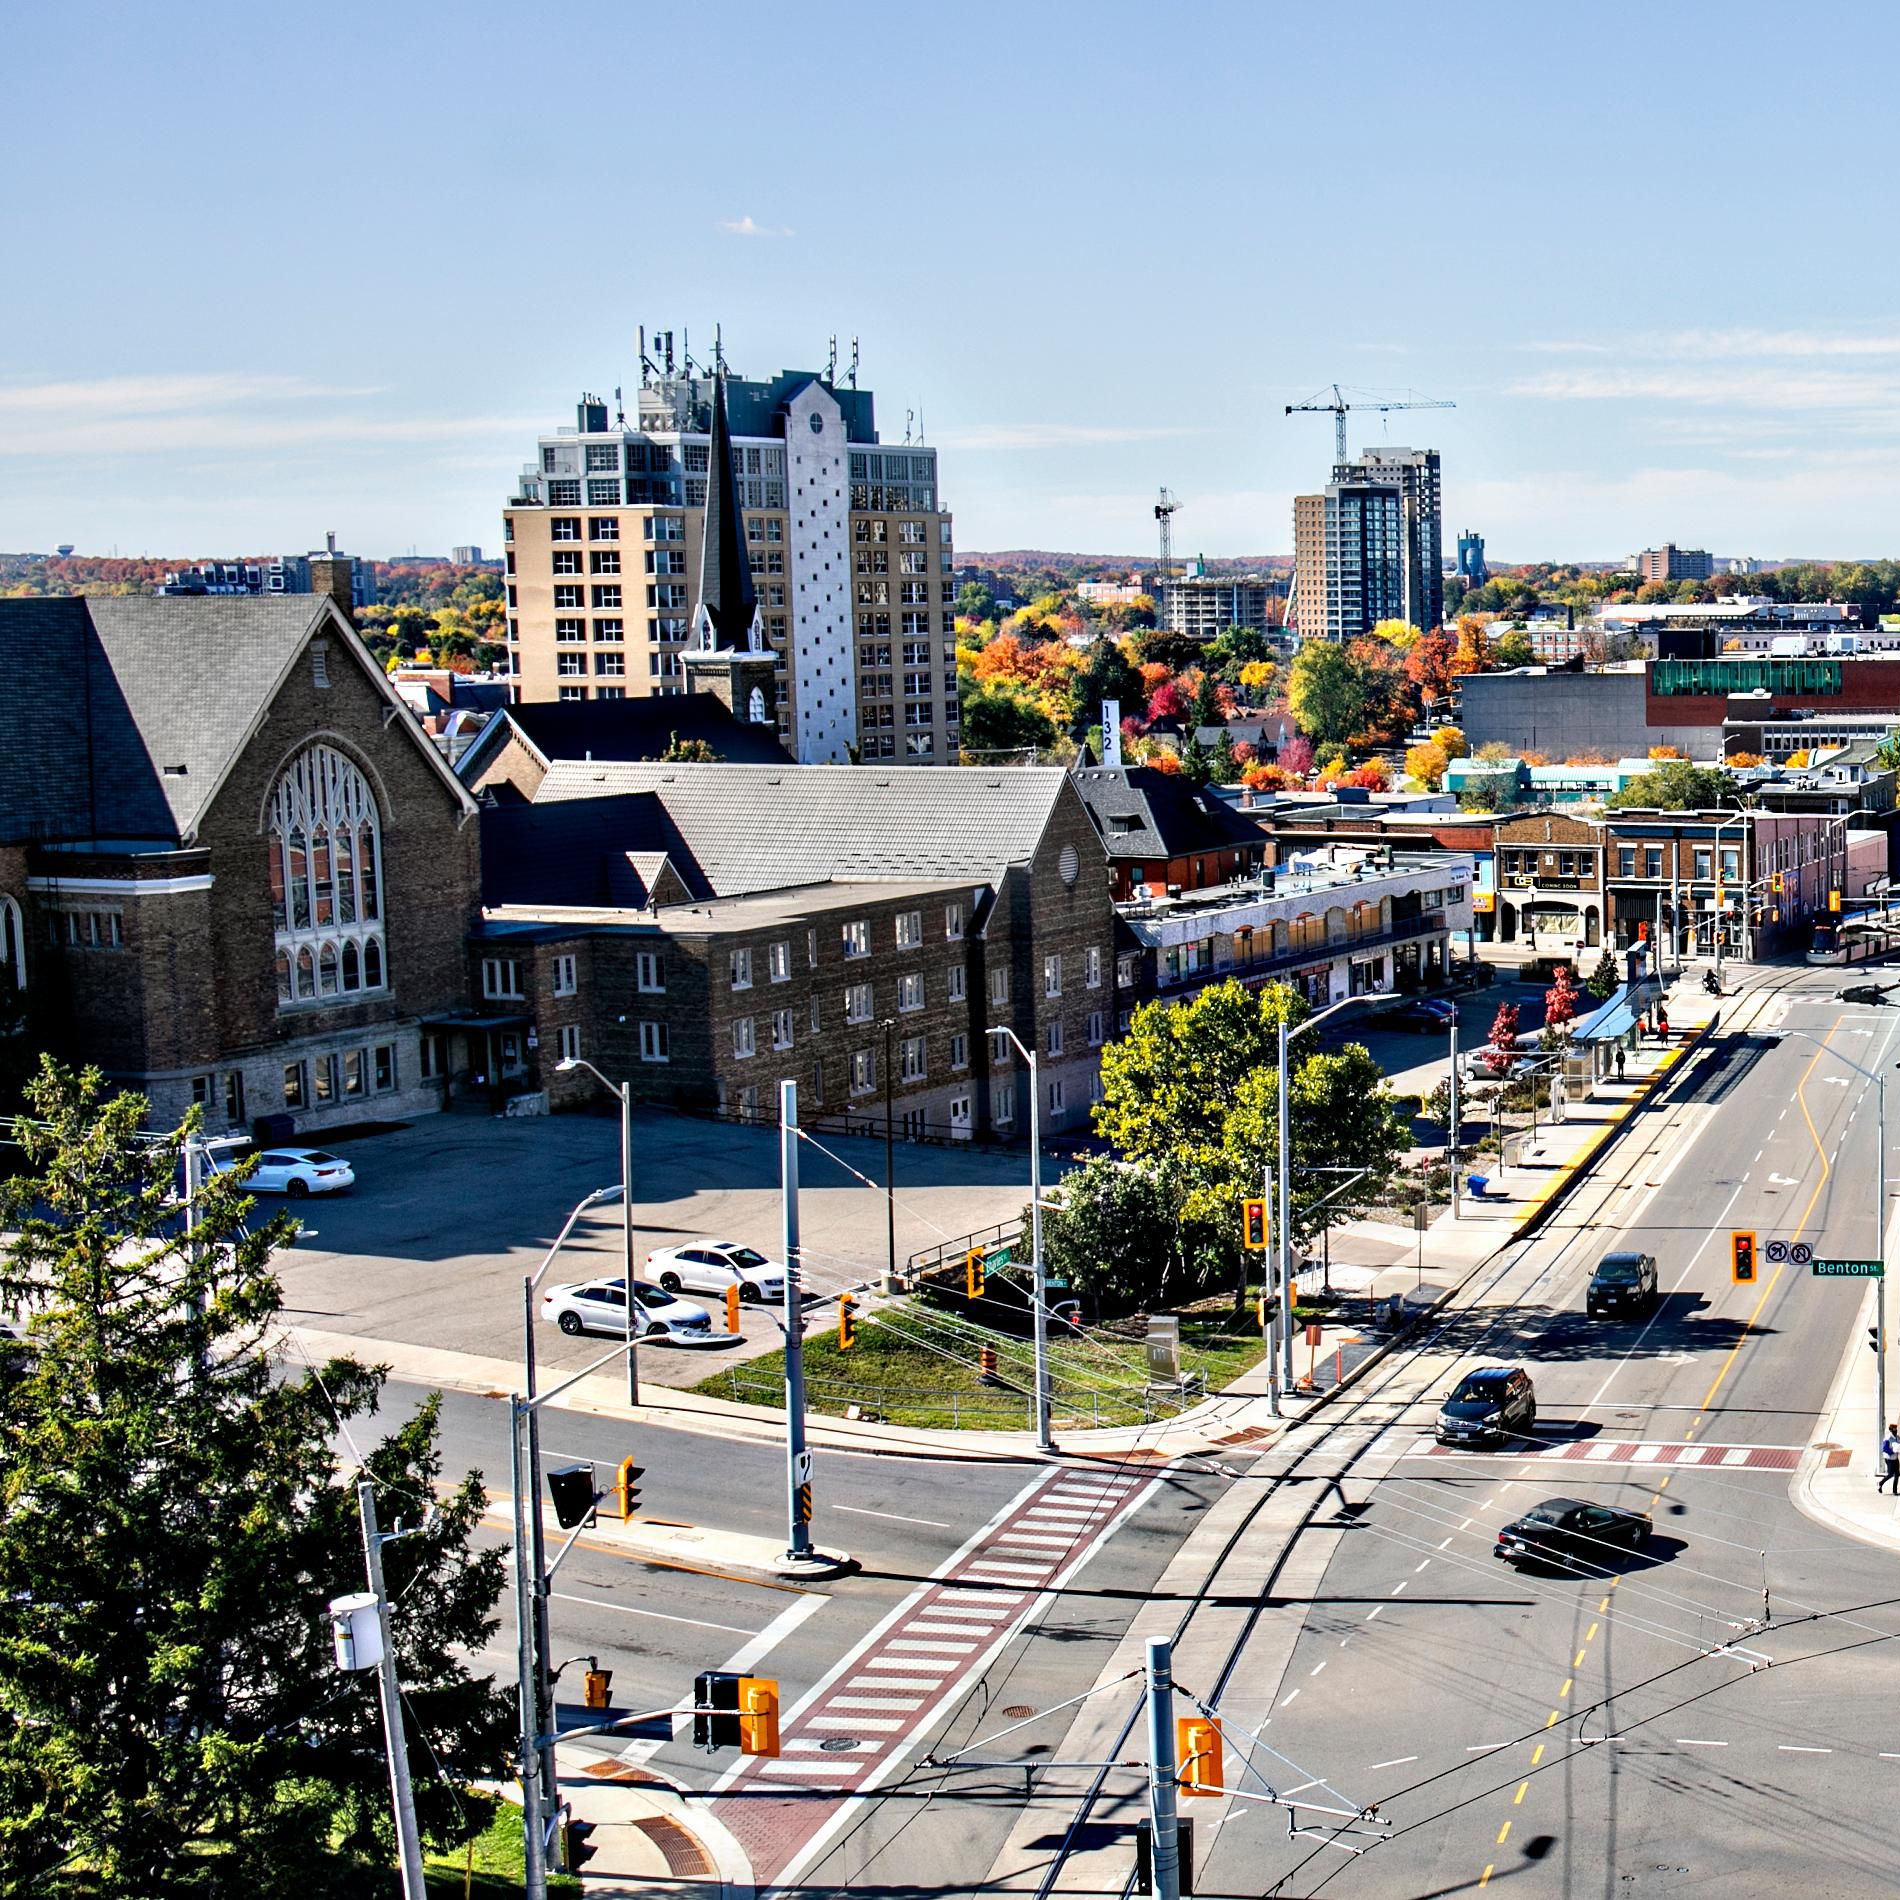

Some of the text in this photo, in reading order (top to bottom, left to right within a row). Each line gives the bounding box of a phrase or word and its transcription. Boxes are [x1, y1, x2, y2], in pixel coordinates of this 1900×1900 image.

[1104, 705, 1112, 750] 132
[1818, 1262, 1879, 1274] Benton St.
